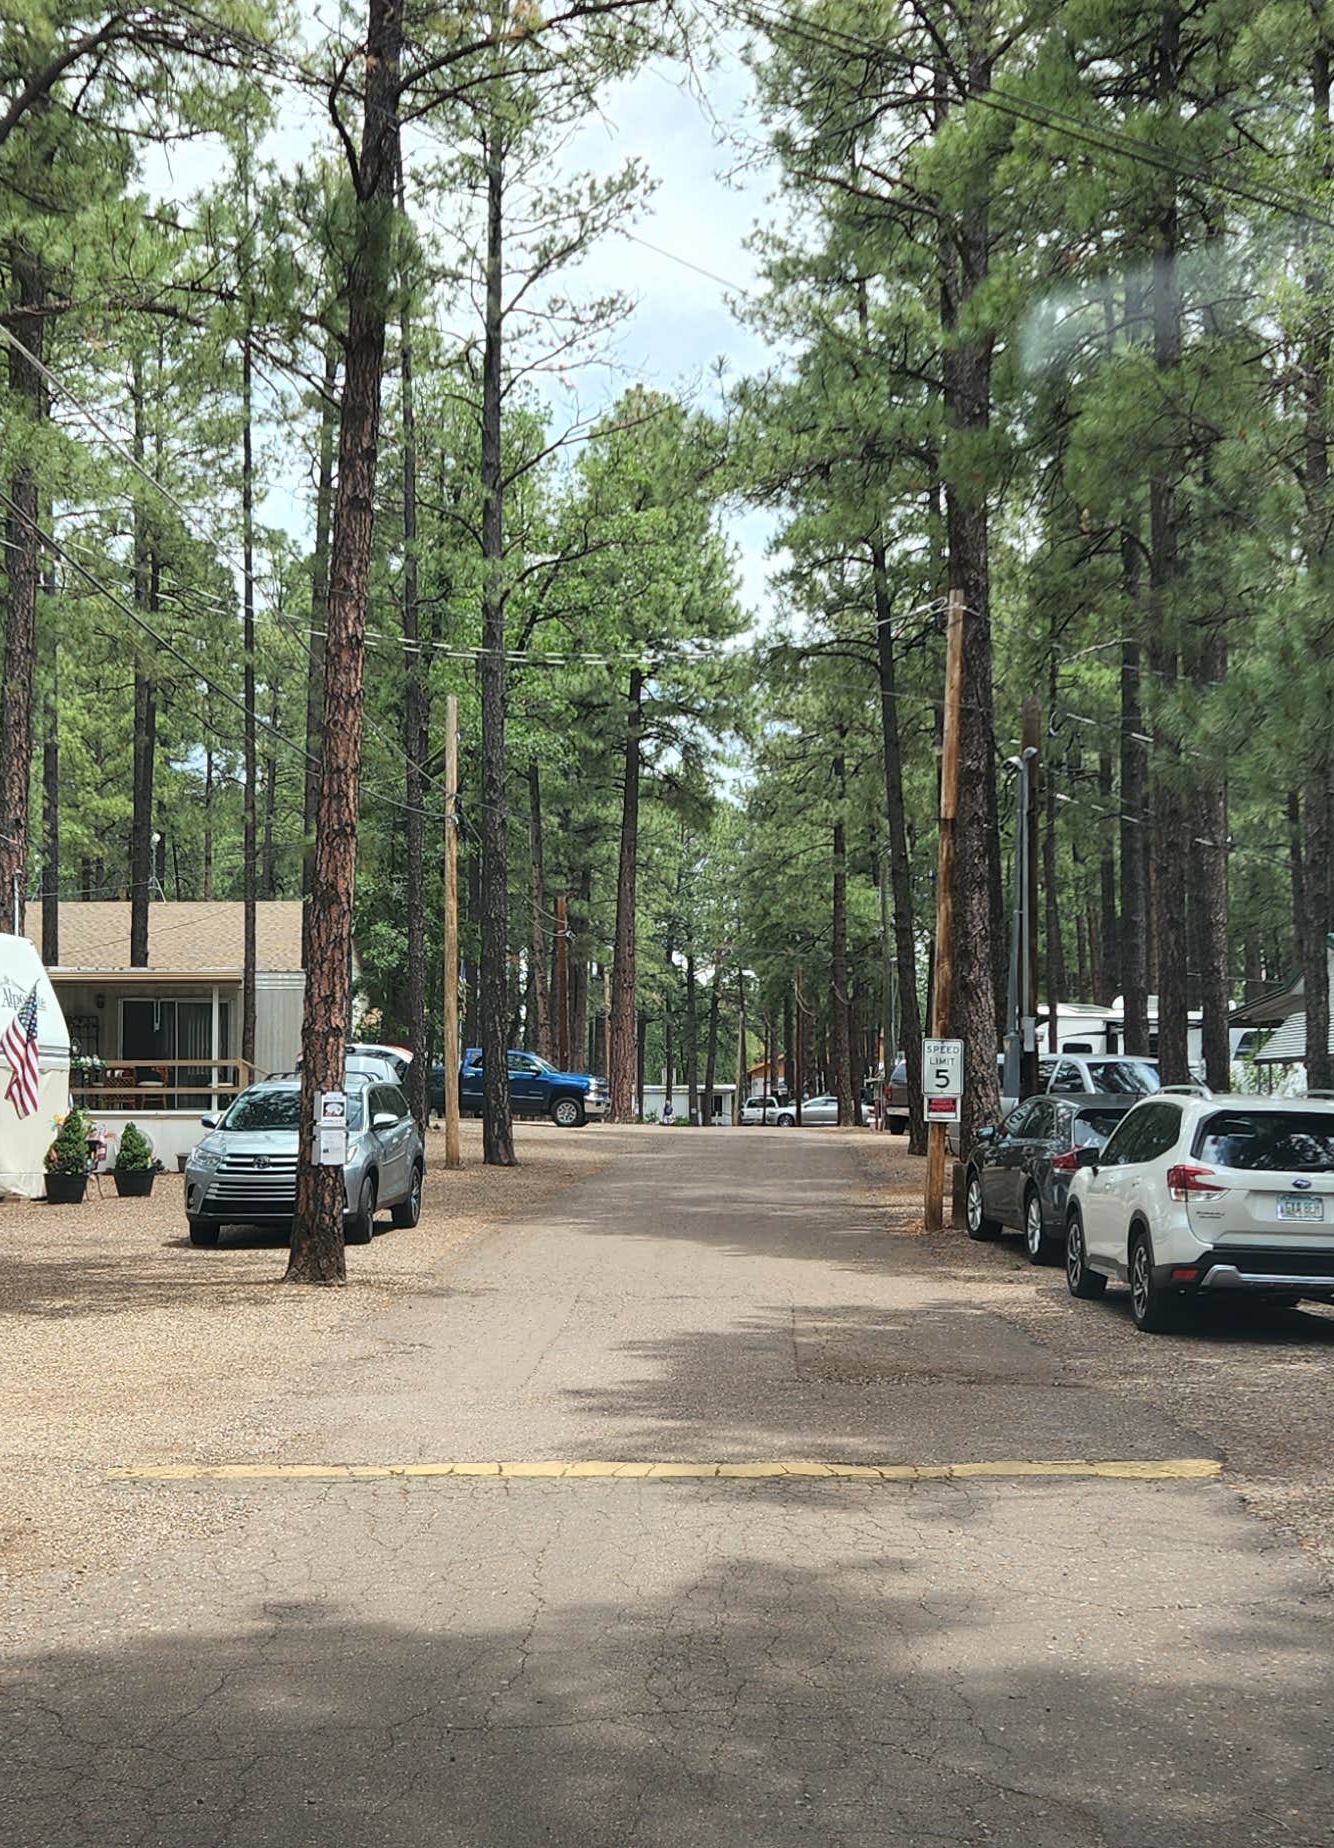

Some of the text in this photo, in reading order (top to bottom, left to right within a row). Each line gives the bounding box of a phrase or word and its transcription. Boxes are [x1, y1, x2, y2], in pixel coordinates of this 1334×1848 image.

[926, 1045, 960, 1055] SPEED
[929, 1057, 955, 1066] LIMIT
[935, 1069, 951, 1089] 5
